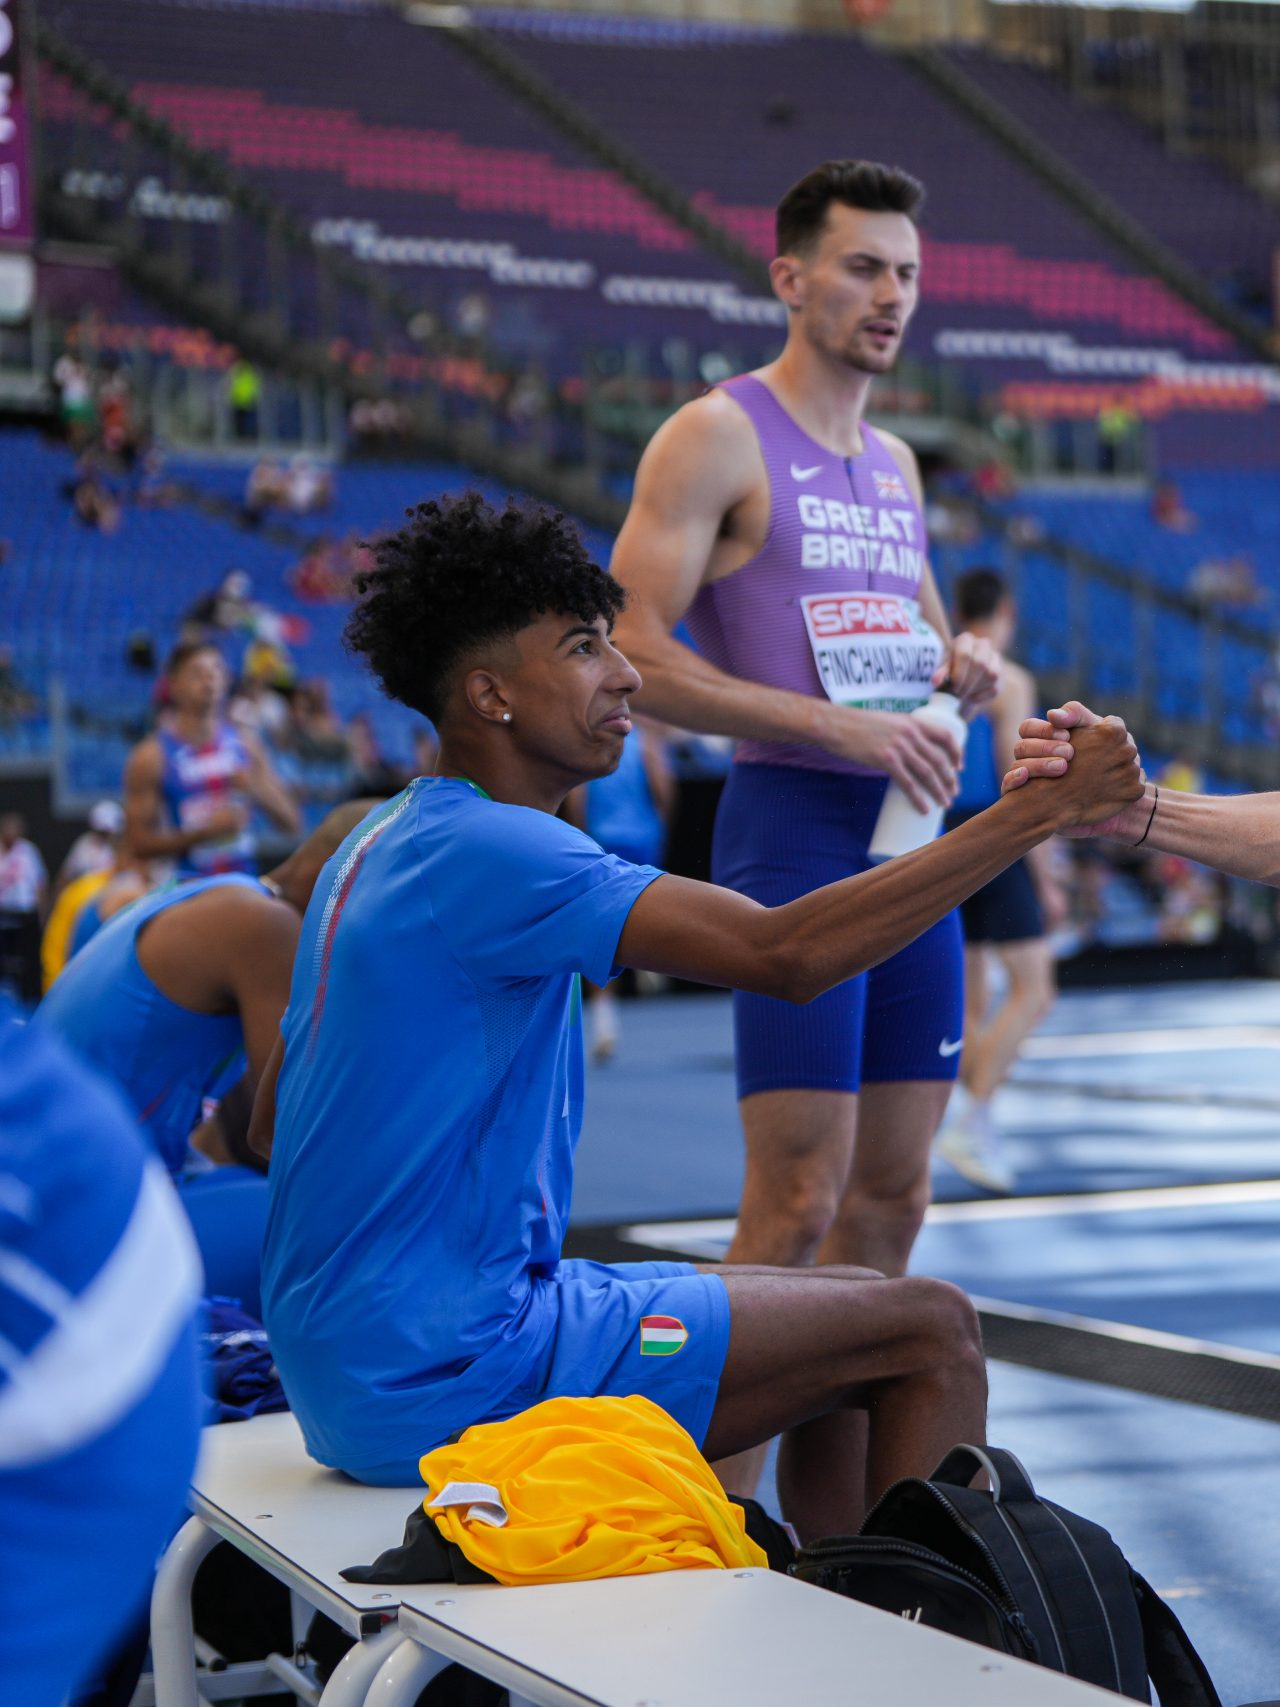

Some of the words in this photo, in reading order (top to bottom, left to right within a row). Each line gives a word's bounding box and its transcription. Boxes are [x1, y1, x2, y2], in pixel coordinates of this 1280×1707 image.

[797, 494, 917, 542] GREAT
[800, 533, 923, 583] BRITAIN
[812, 600, 910, 634] SPAR
